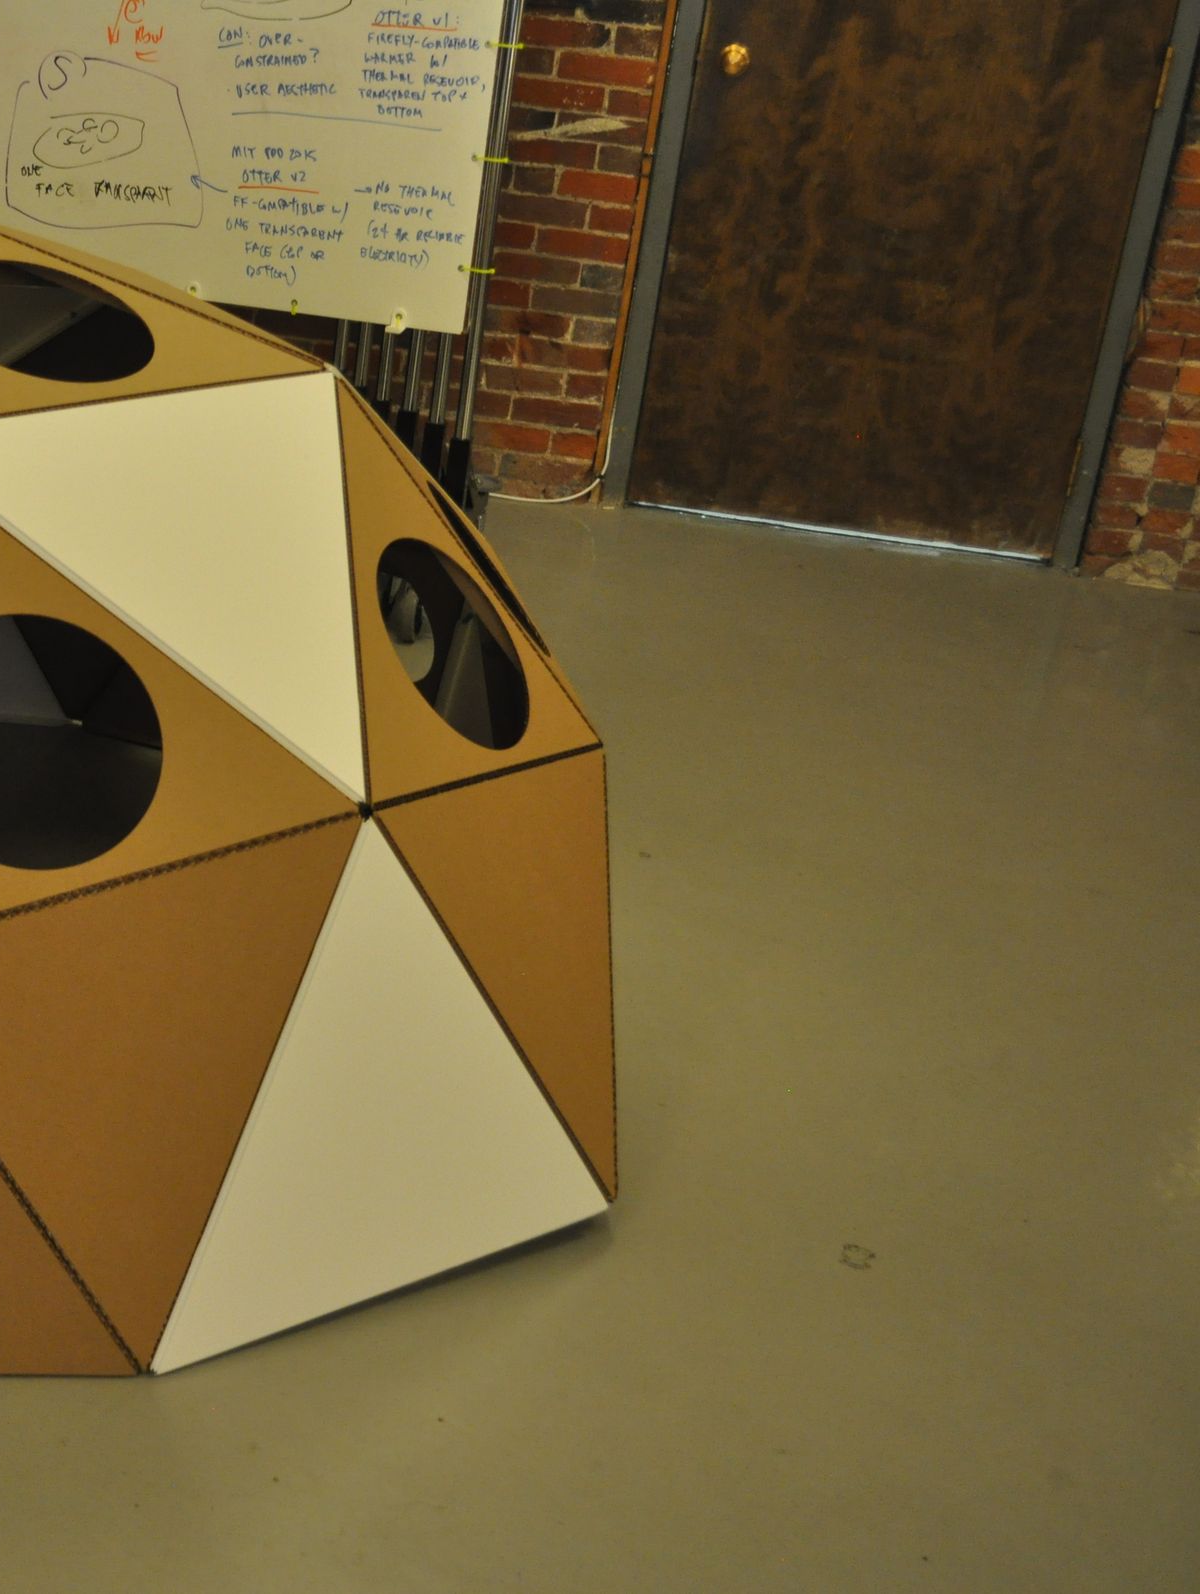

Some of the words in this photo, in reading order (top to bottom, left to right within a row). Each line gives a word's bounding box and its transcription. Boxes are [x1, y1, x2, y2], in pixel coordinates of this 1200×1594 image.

[364, 52, 415, 65] WARMER
[362, 68, 414, 84] THERMAL
[377, 104, 423, 118] BOTTOM
[231, 145, 256, 159] MIT
[242, 168, 282, 185] OTTER
[35, 182, 75, 198] FACE
[398, 184, 455, 207] THERMAL
[225, 217, 249, 232] ONE
[244, 241, 273, 258] FACE
